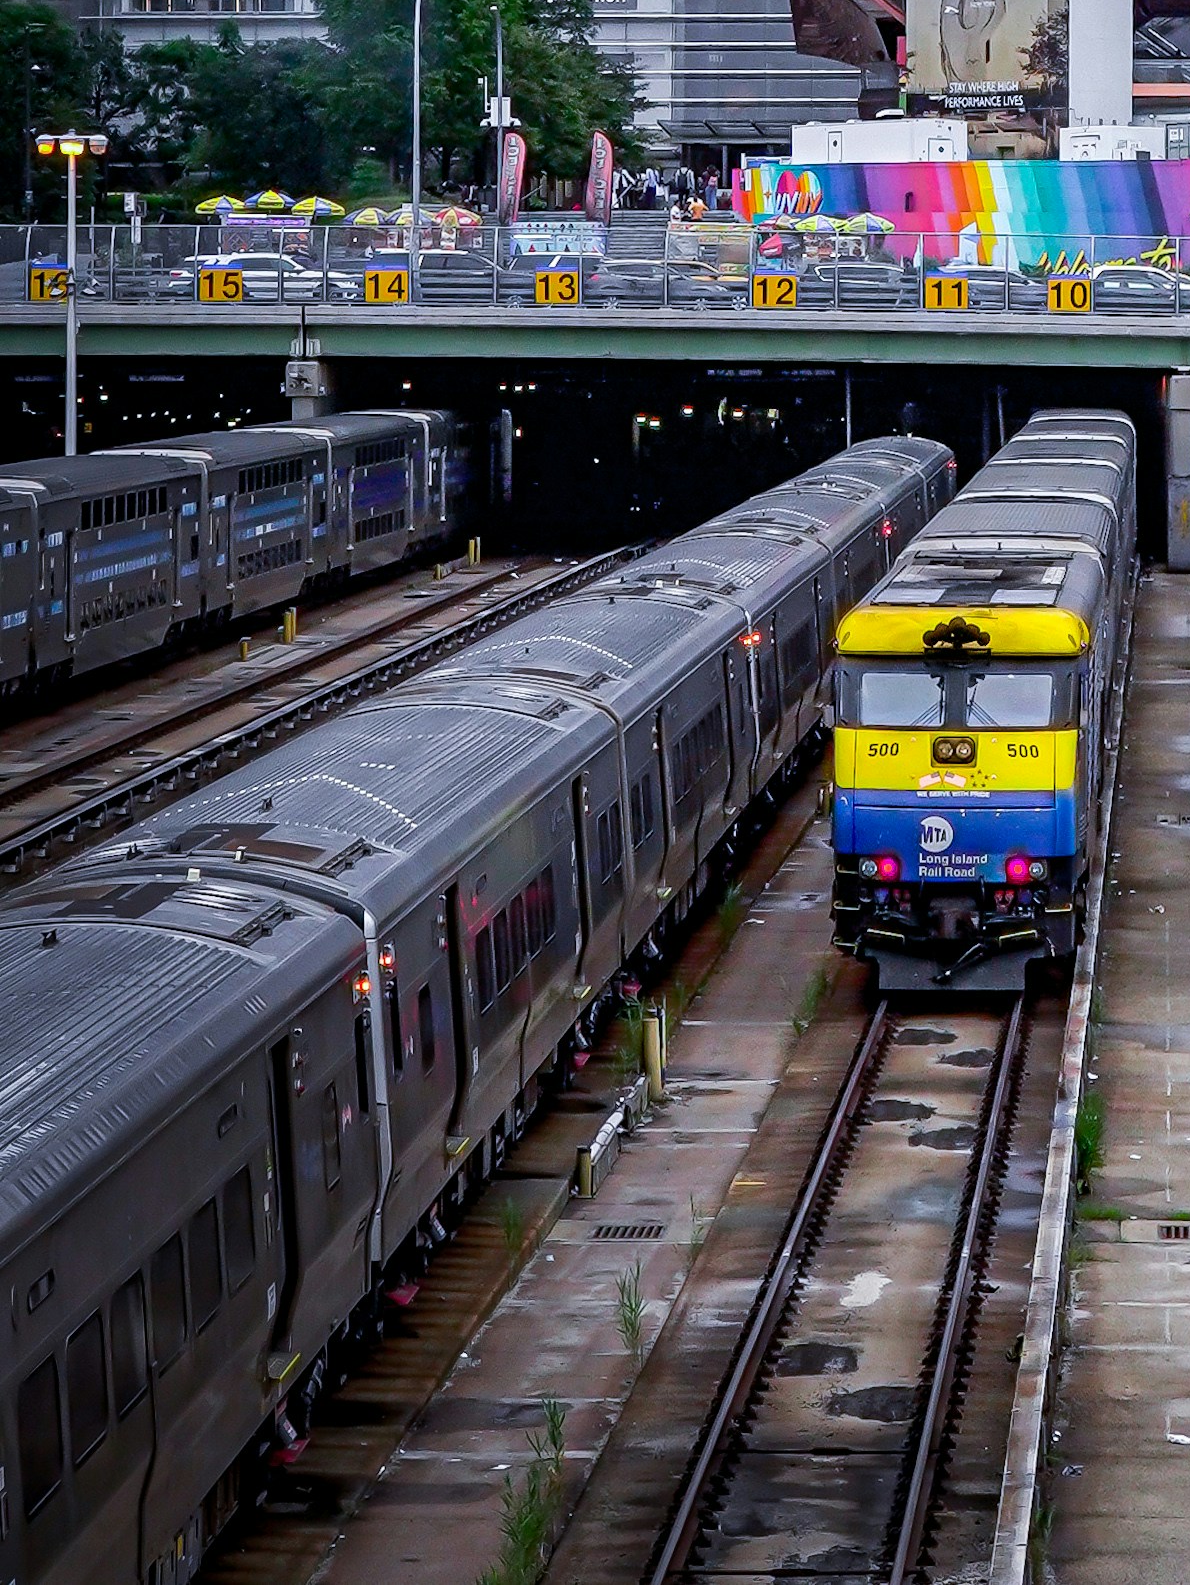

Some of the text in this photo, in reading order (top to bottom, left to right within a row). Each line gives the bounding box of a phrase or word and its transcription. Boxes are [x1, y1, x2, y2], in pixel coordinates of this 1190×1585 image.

[203, 273, 239, 299] 15
[369, 273, 405, 299] 14
[538, 274, 576, 300] 13
[756, 279, 794, 304] 12
[931, 281, 962, 307] 11
[1050, 282, 1087, 308] 10
[867, 742, 899, 757] 500
[1007, 743, 1039, 758] 500
[920, 826, 947, 844] MTA
[919, 853, 988, 866] Long Island
[919, 866, 975, 877] Rail Road
